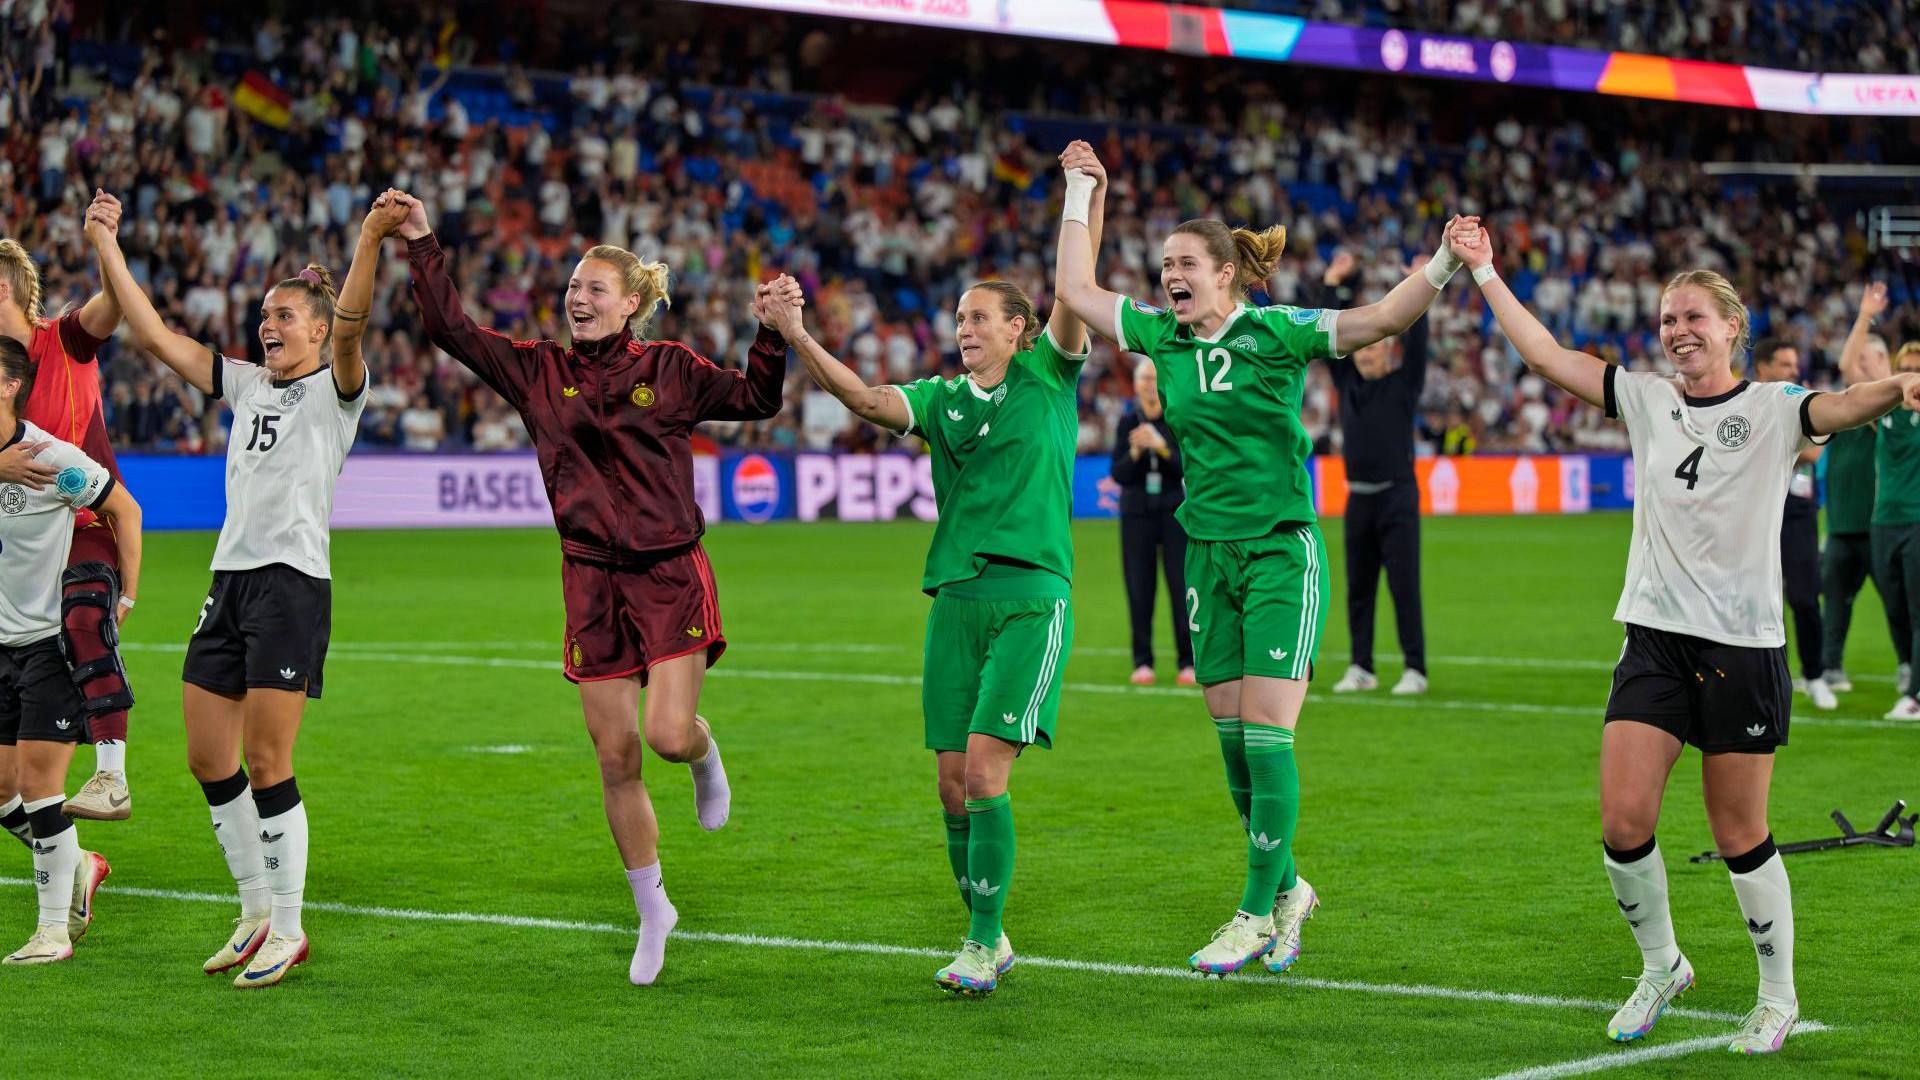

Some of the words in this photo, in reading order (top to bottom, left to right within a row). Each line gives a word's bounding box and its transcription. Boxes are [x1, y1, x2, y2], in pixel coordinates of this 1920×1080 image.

[1196, 347, 1232, 393] 12
[246, 414, 281, 452] 15
[795, 453, 939, 522] PEPS
[1675, 446, 1704, 490] 4
[439, 472, 544, 511] BASEL
